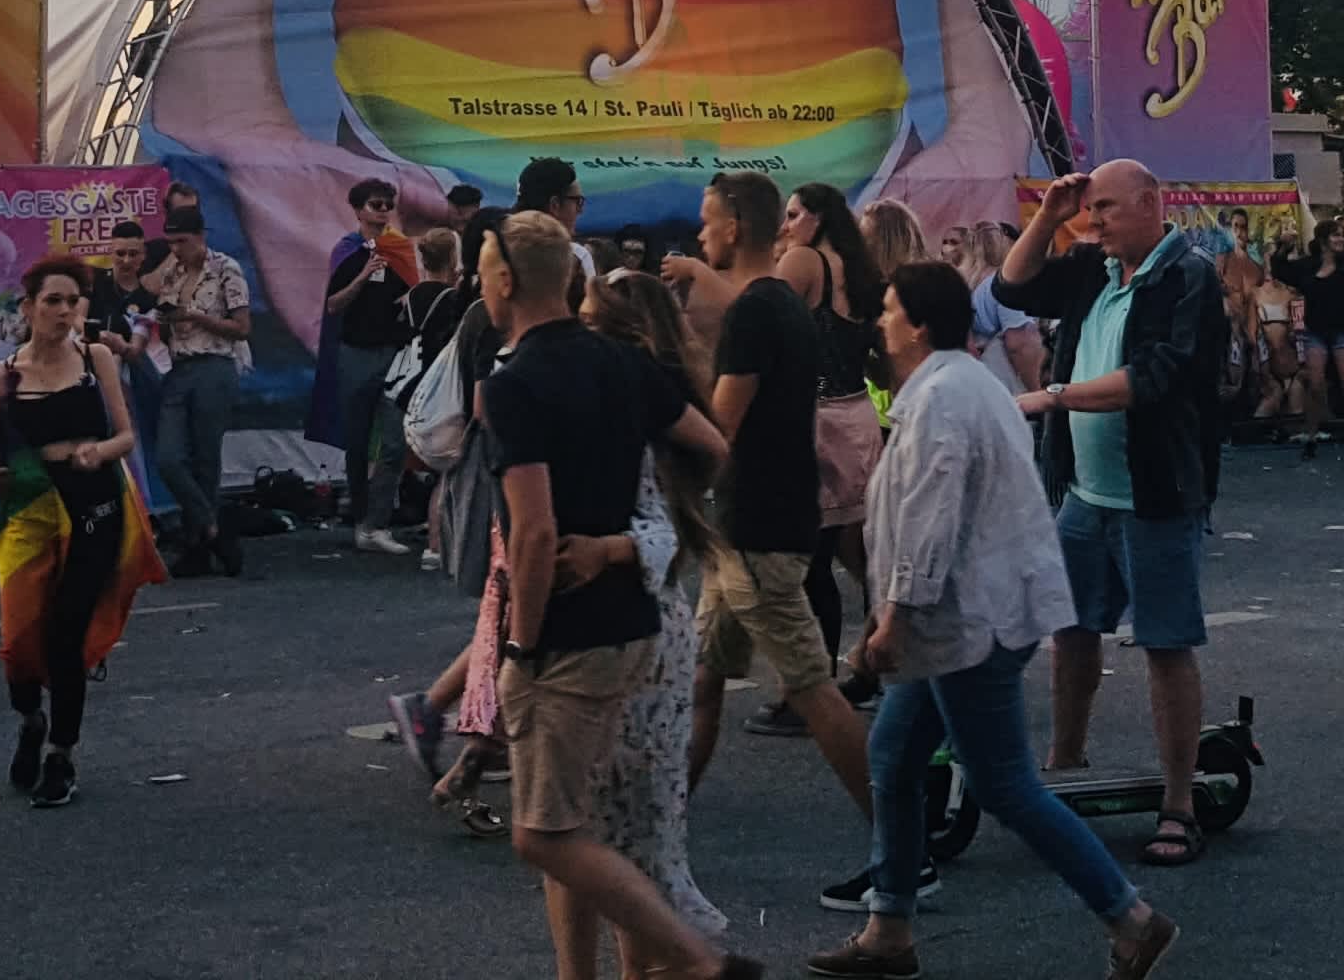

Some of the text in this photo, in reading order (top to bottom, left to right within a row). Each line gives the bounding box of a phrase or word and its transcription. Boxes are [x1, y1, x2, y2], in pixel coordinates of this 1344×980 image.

[448, 97, 557, 117] Talstrasse
[564, 100, 588, 116] 14
[604, 100, 631, 117] St.
[637, 100, 683, 117] Pauli
[698, 101, 762, 122] Täglich
[768, 104, 788, 120] ab
[792, 105, 835, 122] 22:00
[63, 217, 129, 243] FRE
